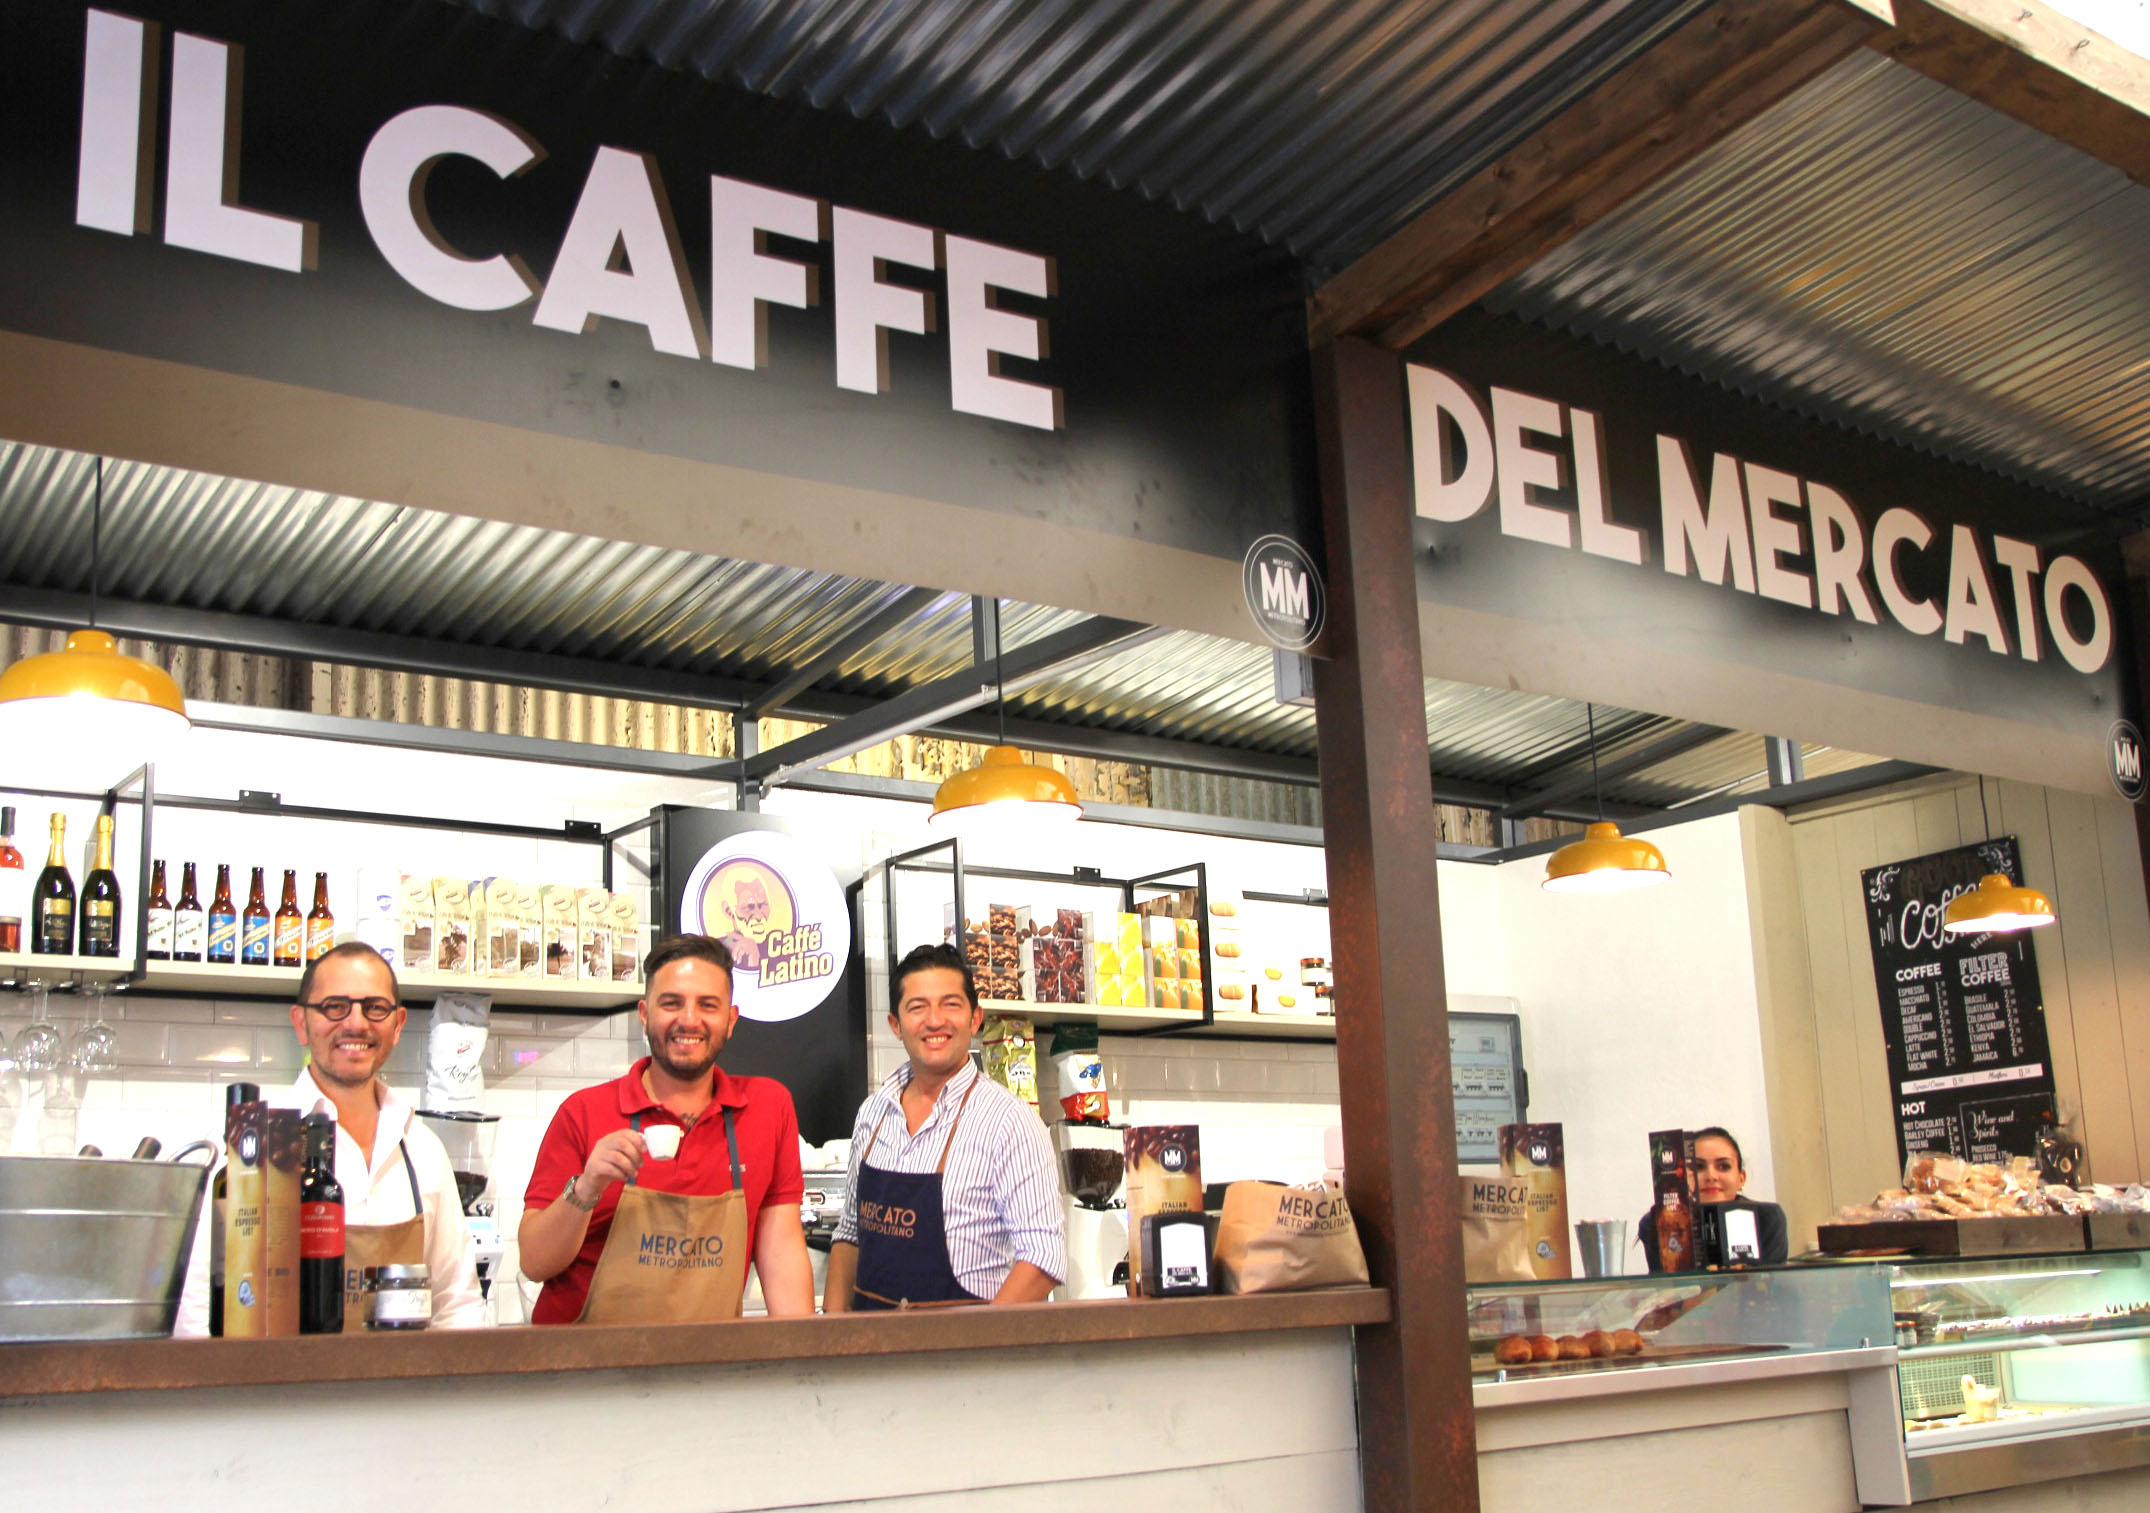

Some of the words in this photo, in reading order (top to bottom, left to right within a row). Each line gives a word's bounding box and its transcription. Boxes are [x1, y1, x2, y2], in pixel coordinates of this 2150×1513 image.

[75, 8, 304, 274] IL
[358, 103, 1055, 431] CAFFE
[1405, 362, 1643, 566] DEL
[1655, 432, 2112, 674] MERCATO
[1260, 561, 1310, 620] MM
[2114, 740, 2141, 779] MM
[767, 922, 822, 958] Caffé
[758, 953, 834, 988] Latino
[1959, 952, 2009, 975] FILTER
[1895, 963, 1942, 982] COFFEE
[1961, 968, 2010, 987] COFFEE
[1902, 1012, 1933, 1025] AMERICANO
[1976, 1020, 2006, 1033] SALVADOR
[1904, 1031, 1937, 1044] CAPPUCCINO
[1906, 1042, 1921, 1053] LATTE
[1971, 1042, 1990, 1053] KENYA
[1907, 1052, 1920, 1062] FLAT
[1920, 1050, 1938, 1061] WHITE
[1973, 1051, 1999, 1062] JAMAICA
[1901, 1101, 1926, 1116] HOT
[1998, 1110, 2014, 1123] and
[1914, 1118, 1945, 1129] CHOCOLATE
[1925, 1127, 1946, 1138] COFFEE
[1165, 1150, 1182, 1166] MM
[1532, 1146, 1548, 1159] MM
[1473, 1184, 1528, 1202] MERCAT
[860, 1200, 917, 1227] MERCATO
[640, 1233, 724, 1257] MERCATO
[638, 1254, 724, 1270] METROPOLITANO
